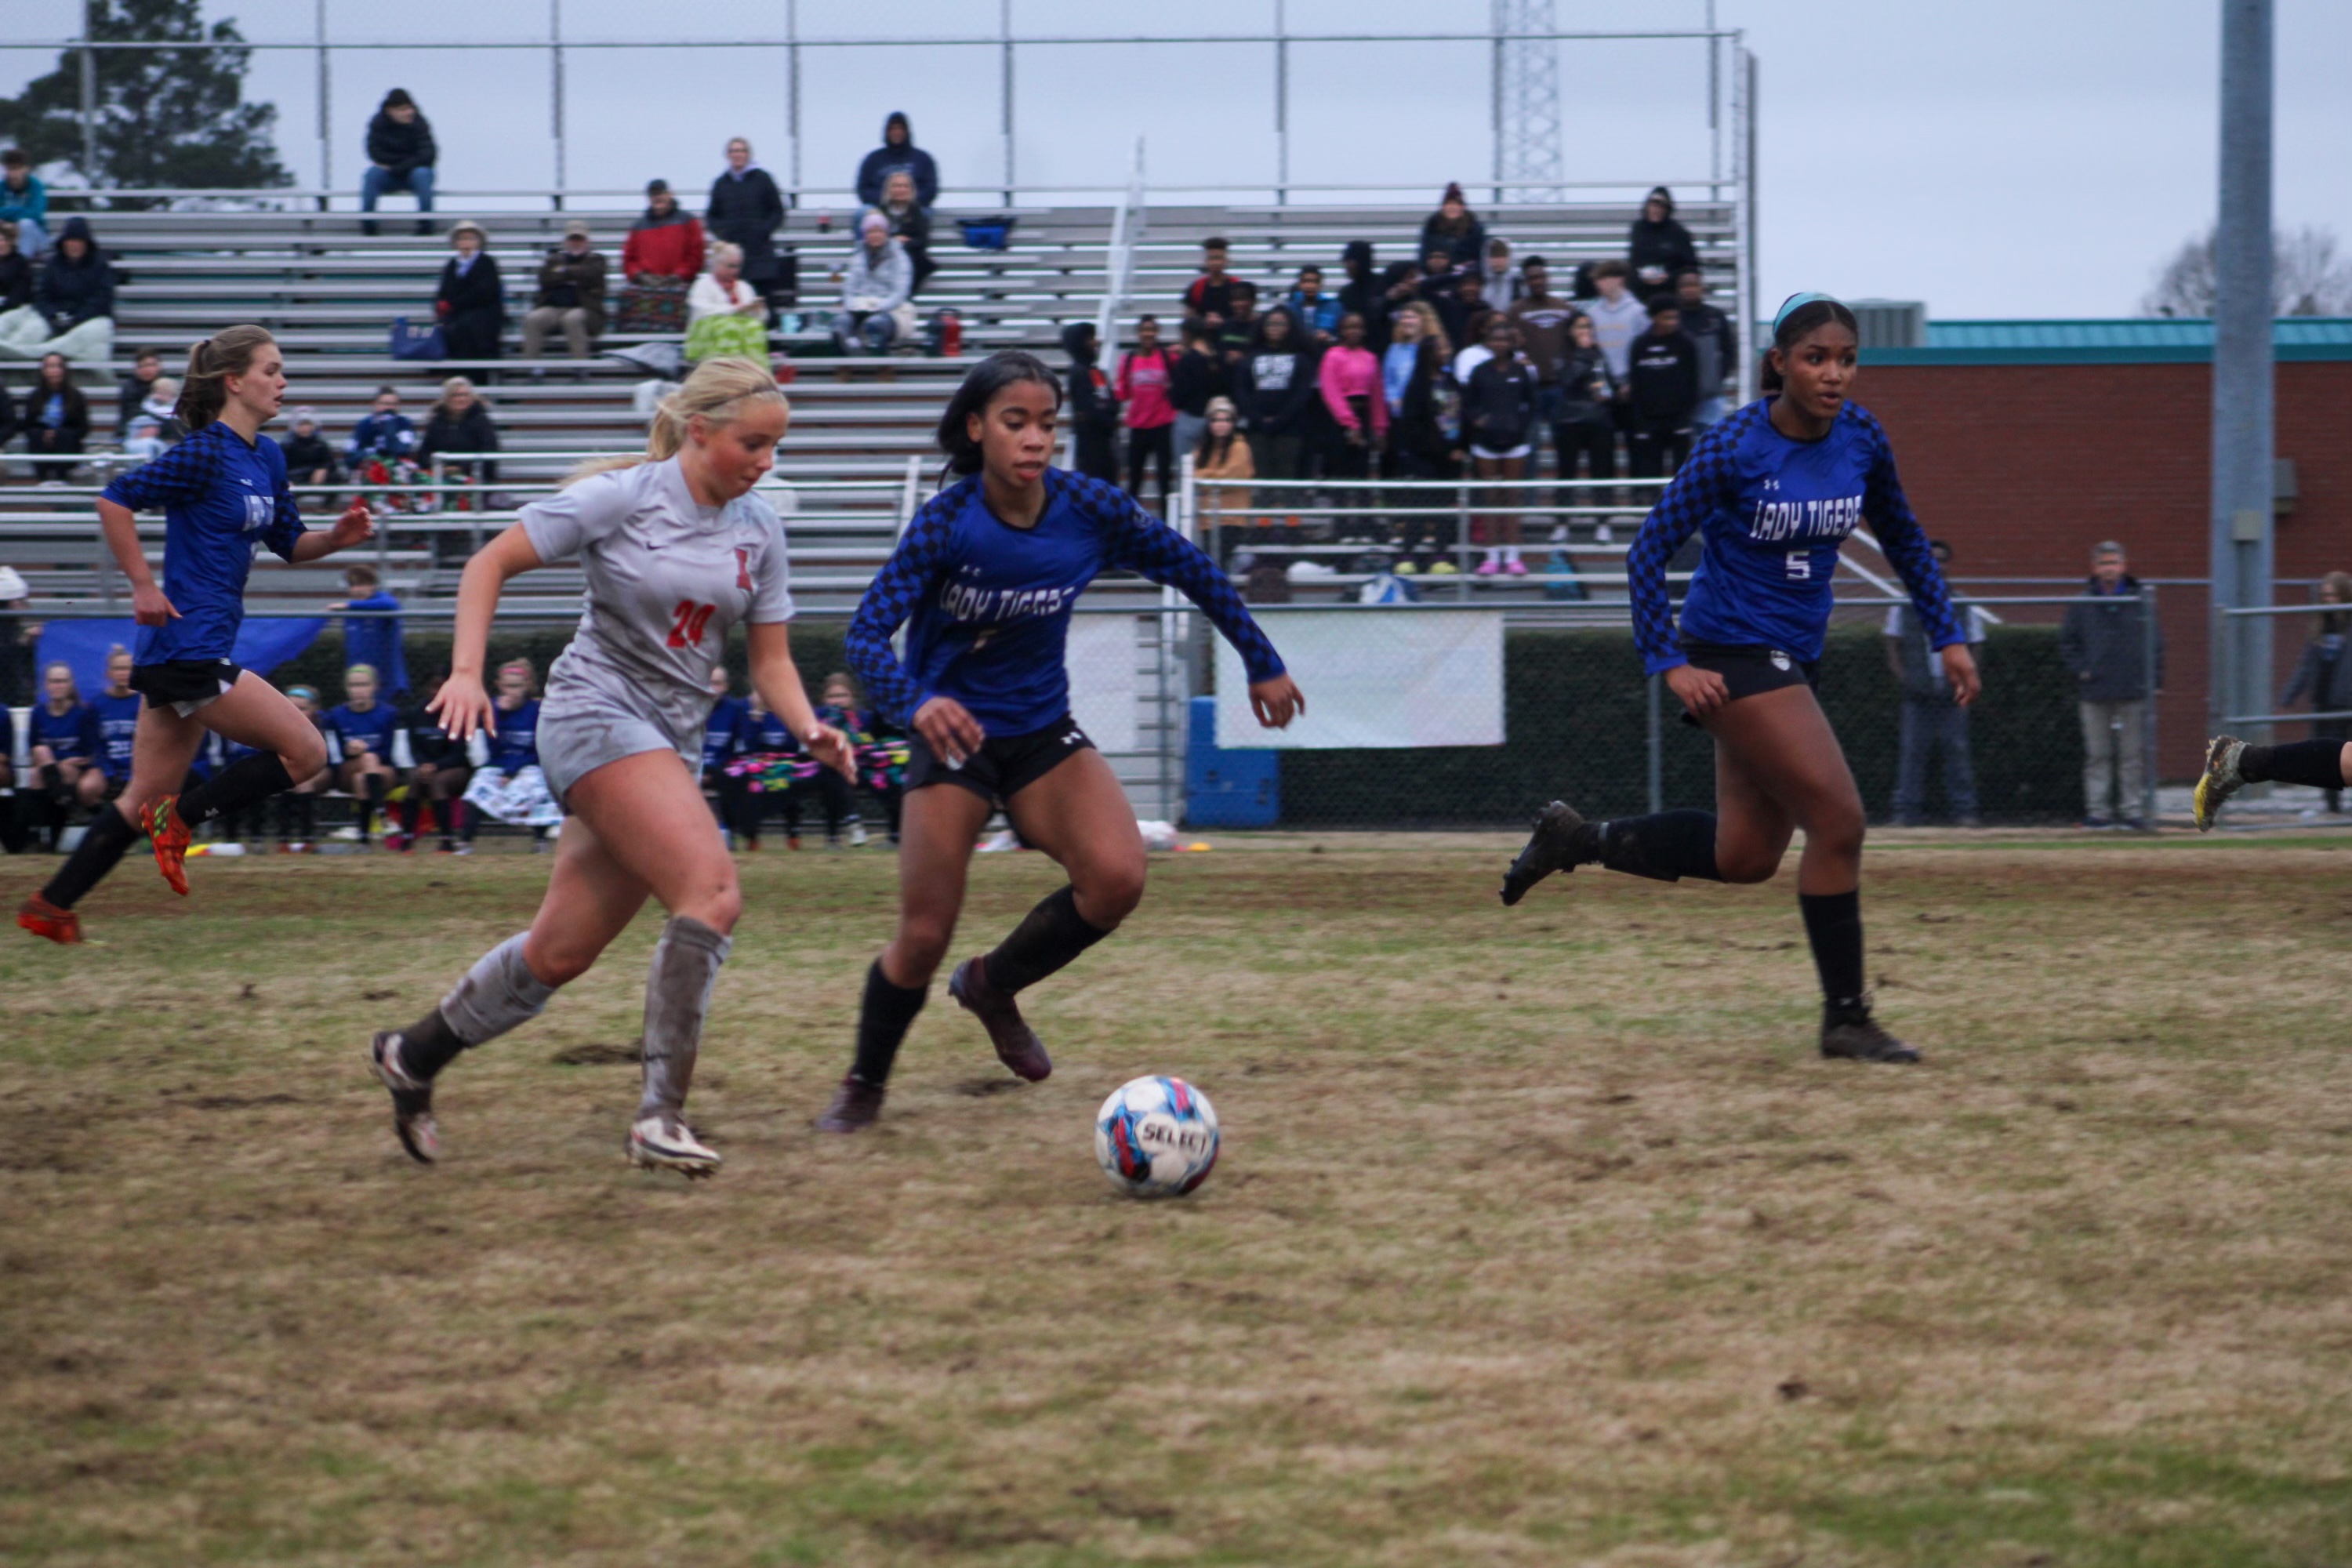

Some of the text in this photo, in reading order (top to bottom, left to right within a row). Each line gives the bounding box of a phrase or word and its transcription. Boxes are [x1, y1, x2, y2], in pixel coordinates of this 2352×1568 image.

[1749, 499, 1802, 540] LADY
[1786, 550, 1810, 579] 5
[941, 579, 993, 622] LADY
[1142, 1123, 1207, 1156] SELECT
